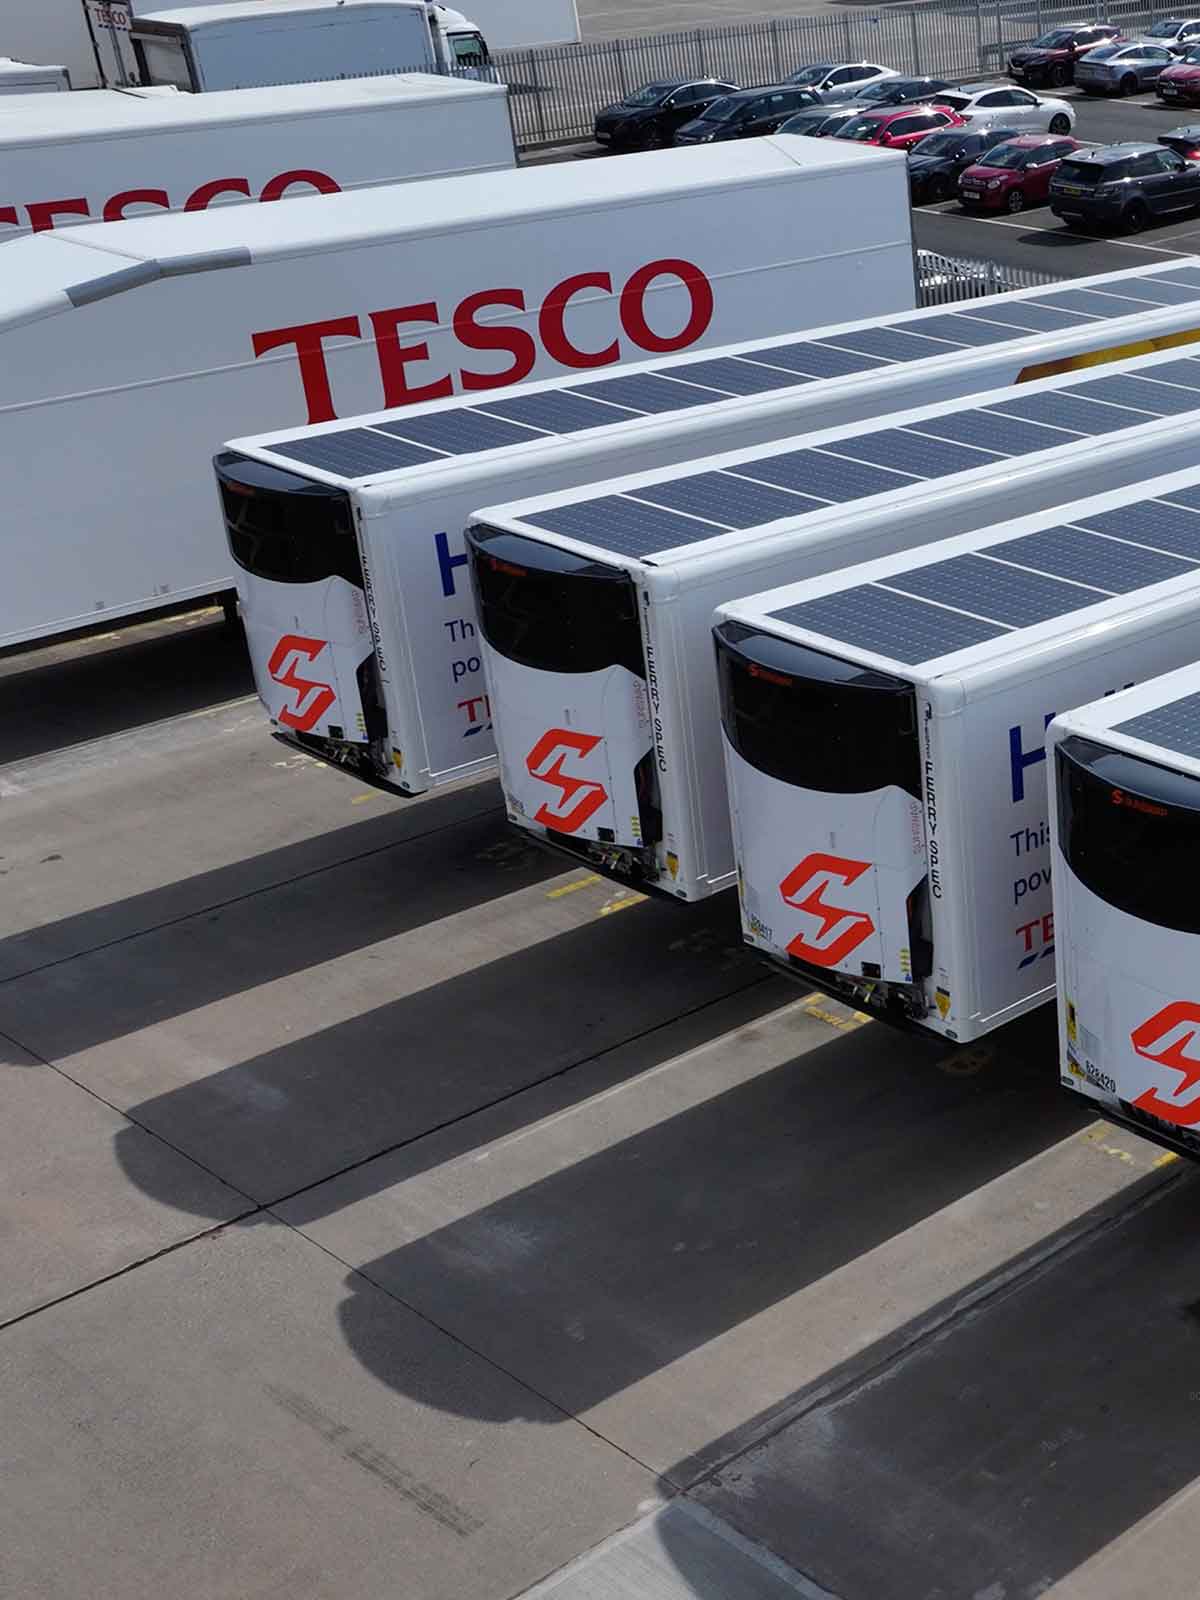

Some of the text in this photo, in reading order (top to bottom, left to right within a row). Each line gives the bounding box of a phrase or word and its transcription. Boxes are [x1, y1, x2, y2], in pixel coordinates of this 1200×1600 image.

[251, 258, 714, 426] TESCO
[646, 646, 660, 715] FERRY
[654, 718, 667, 773] SPEC
[925, 761, 937, 836] FERRY
[929, 840, 942, 899] SPEC
